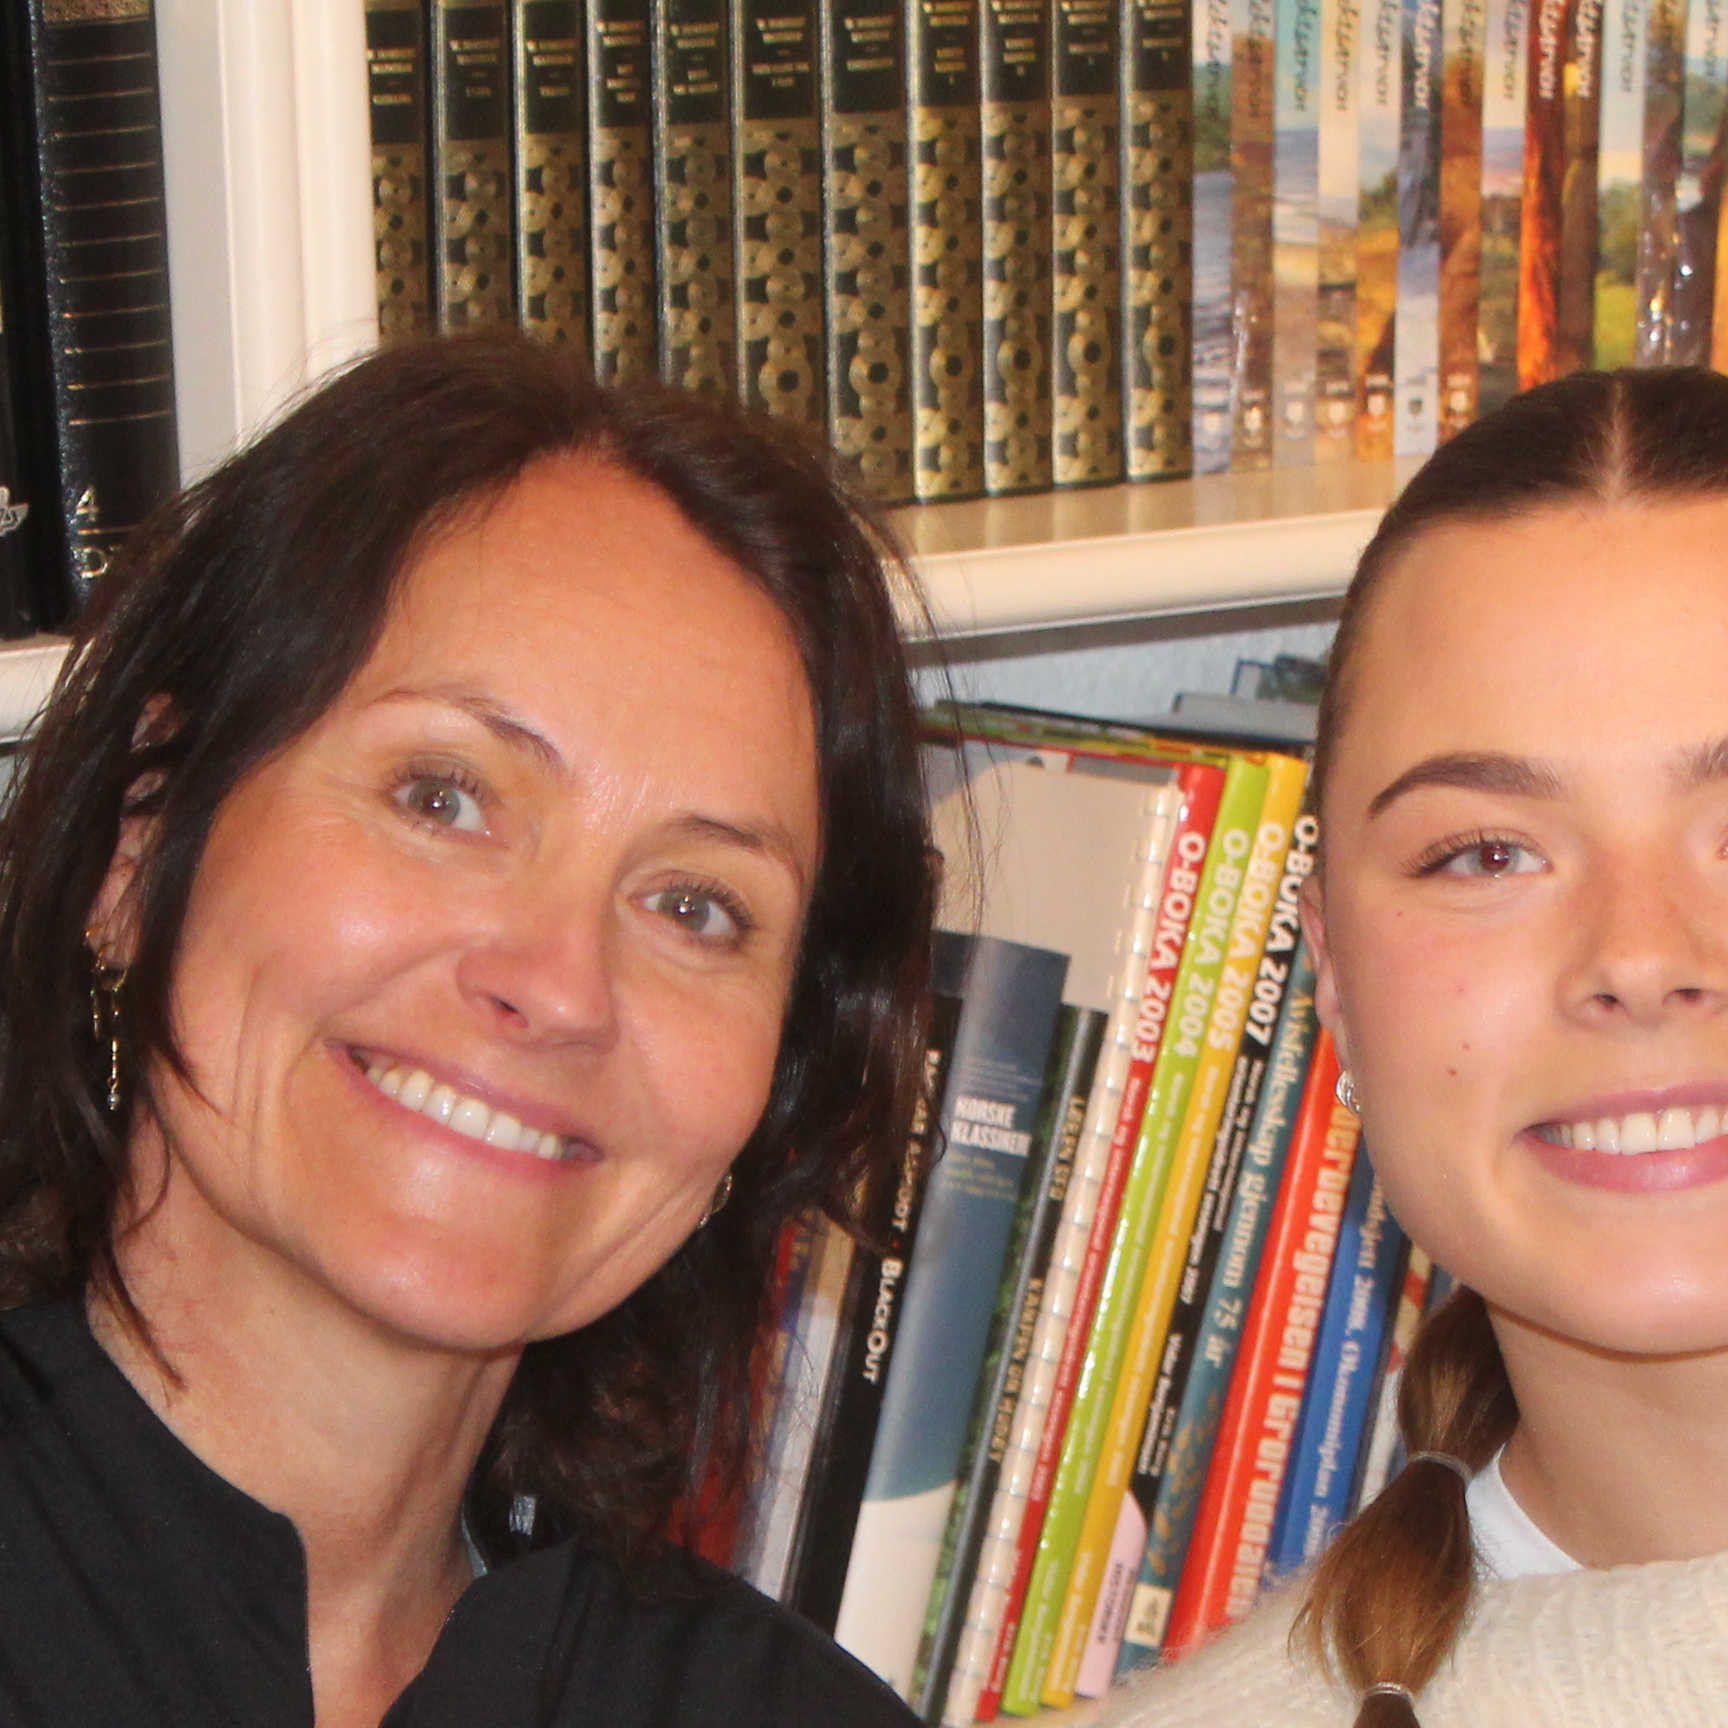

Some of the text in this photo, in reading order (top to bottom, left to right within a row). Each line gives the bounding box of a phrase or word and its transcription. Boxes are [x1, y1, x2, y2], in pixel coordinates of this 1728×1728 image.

[1148, 831, 1208, 970] O-BOKA
[1174, 828, 1251, 1059] O-BOKA 2004
[1207, 822, 1287, 1050] O-BOKA 2005
[1245, 815, 1320, 1047] O-BOKA 2007
[1131, 977, 1171, 1063] 2003
[955, 1096, 1018, 1130] NORSKE
[1204, 1173, 1270, 1369] gjennom 75 år
[1314, 1342, 1361, 1498] Økonomiplan
